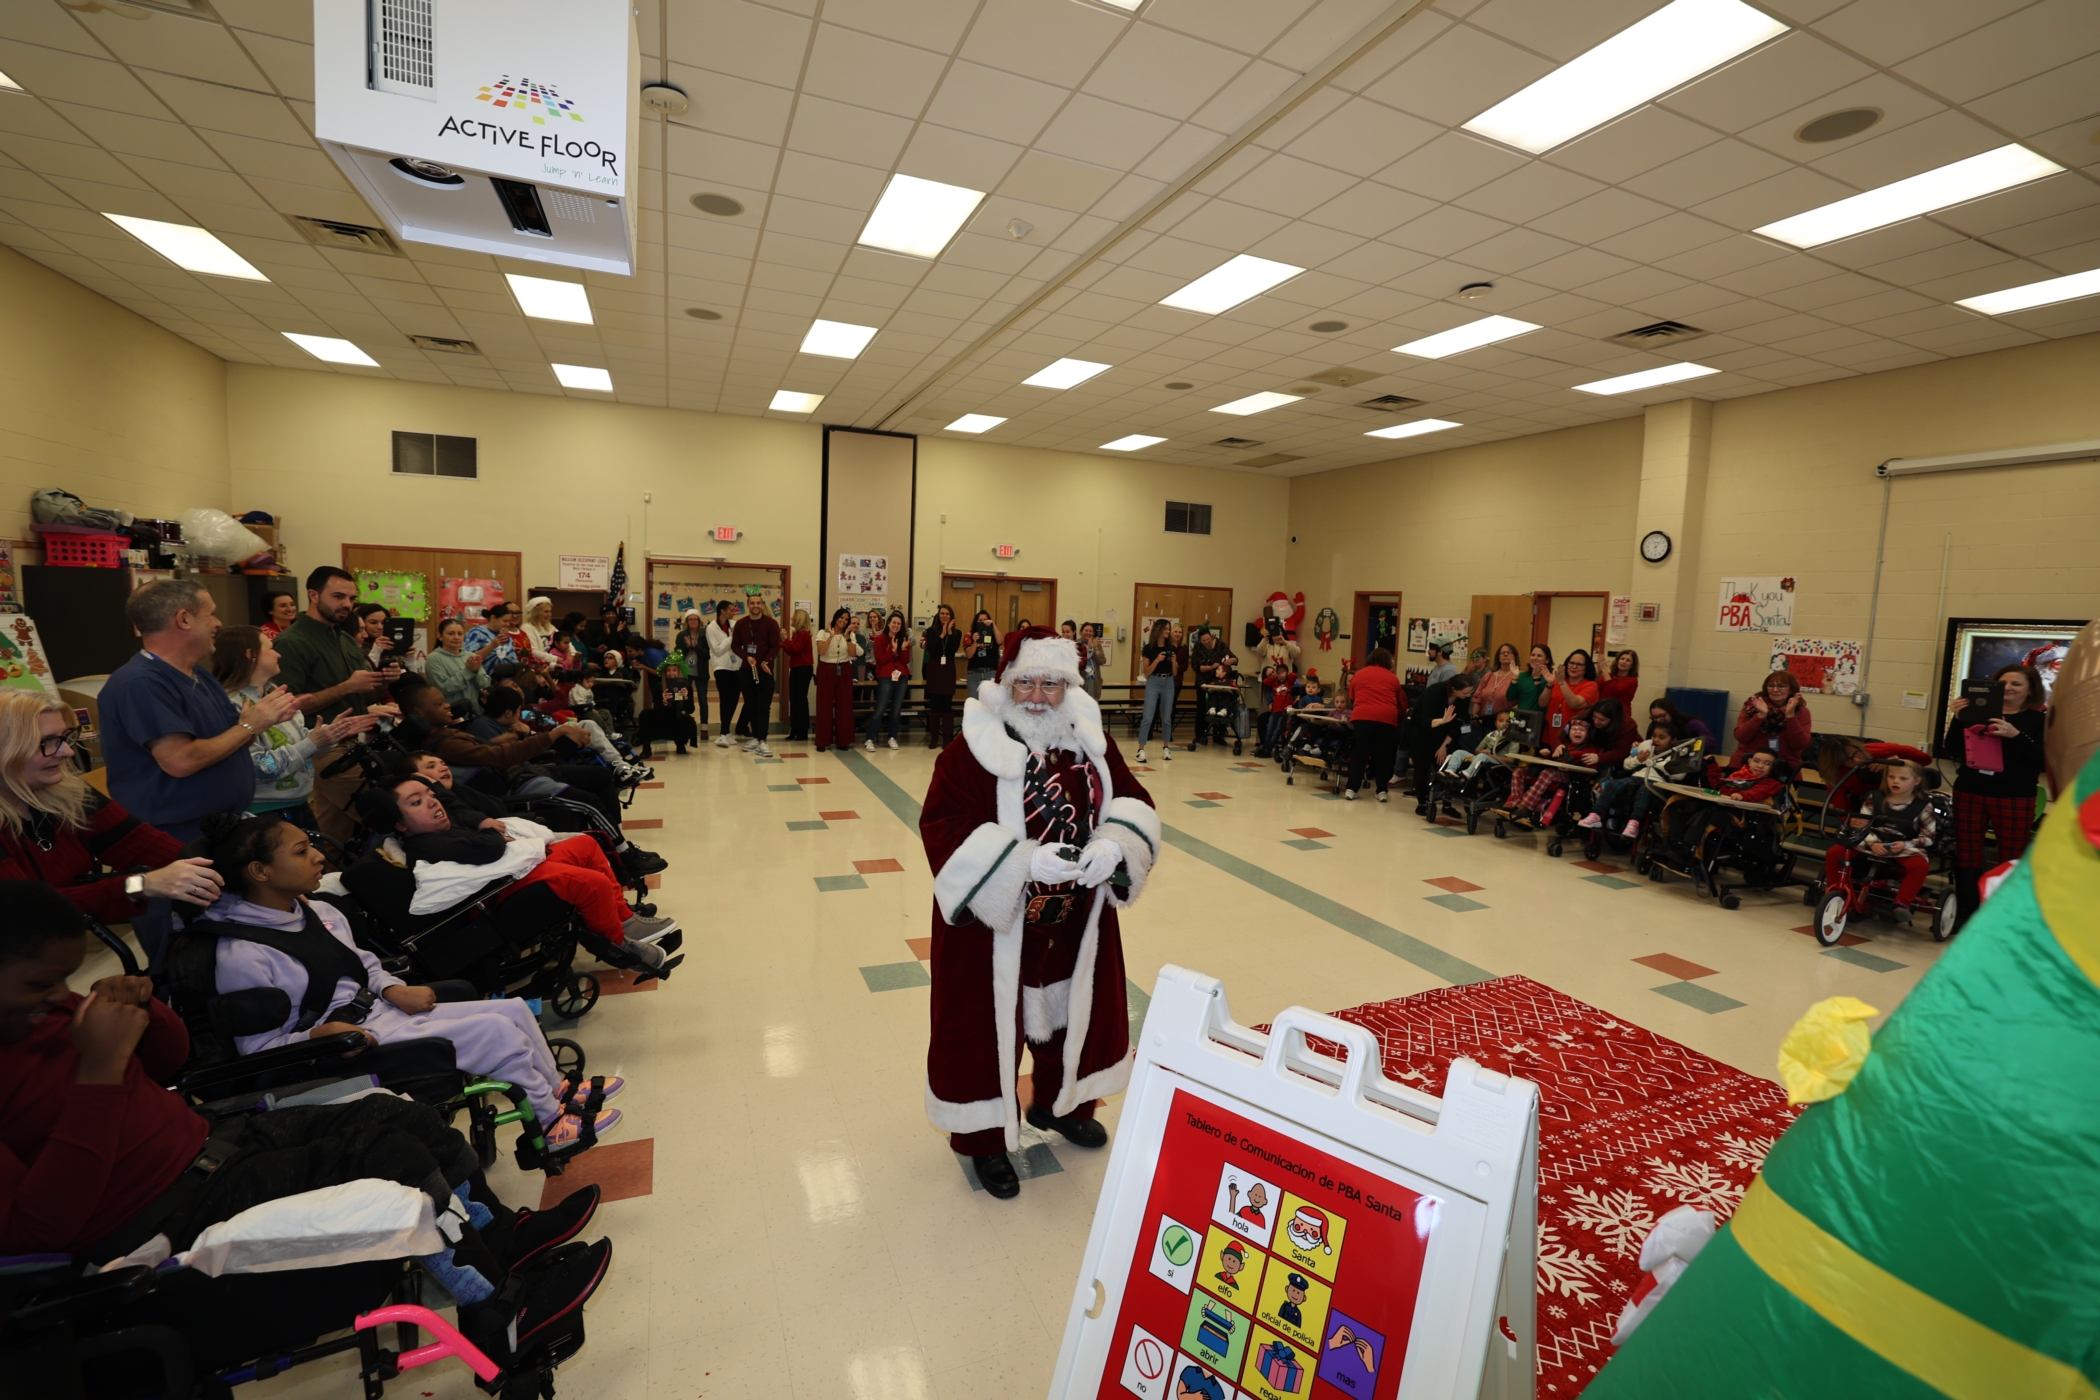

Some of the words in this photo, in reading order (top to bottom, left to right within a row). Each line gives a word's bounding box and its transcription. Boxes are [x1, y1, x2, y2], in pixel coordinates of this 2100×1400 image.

[437, 115, 535, 150] ACTIVE
[541, 134, 619, 177] FLOOR
[541, 163, 567, 179] Jump
[588, 172, 619, 186] Learn
[717, 526, 735, 540] EXIT
[999, 545, 1013, 556] EXIT
[1760, 592, 1784, 607] you
[1720, 605, 1751, 627] PBA
[1186, 1112, 1222, 1139] Tablero
[1223, 1131, 1238, 1146] de
[1239, 1138, 1316, 1182] Comunicacion
[1318, 1175, 1335, 1191] de
[1337, 1181, 1362, 1204] PBA
[1364, 1194, 1402, 1222] Santa
[1232, 1217, 1249, 1234] hola
[1291, 1248, 1316, 1269] Santa
[1217, 1283, 1233, 1298] elfo
[1261, 1311, 1282, 1327] oficial
[1282, 1323, 1292, 1334] de
[1292, 1329, 1315, 1347] policia
[1199, 1348, 1219, 1365] abrir
[1136, 1381, 1147, 1394] no
[1335, 1371, 1357, 1389] mas
